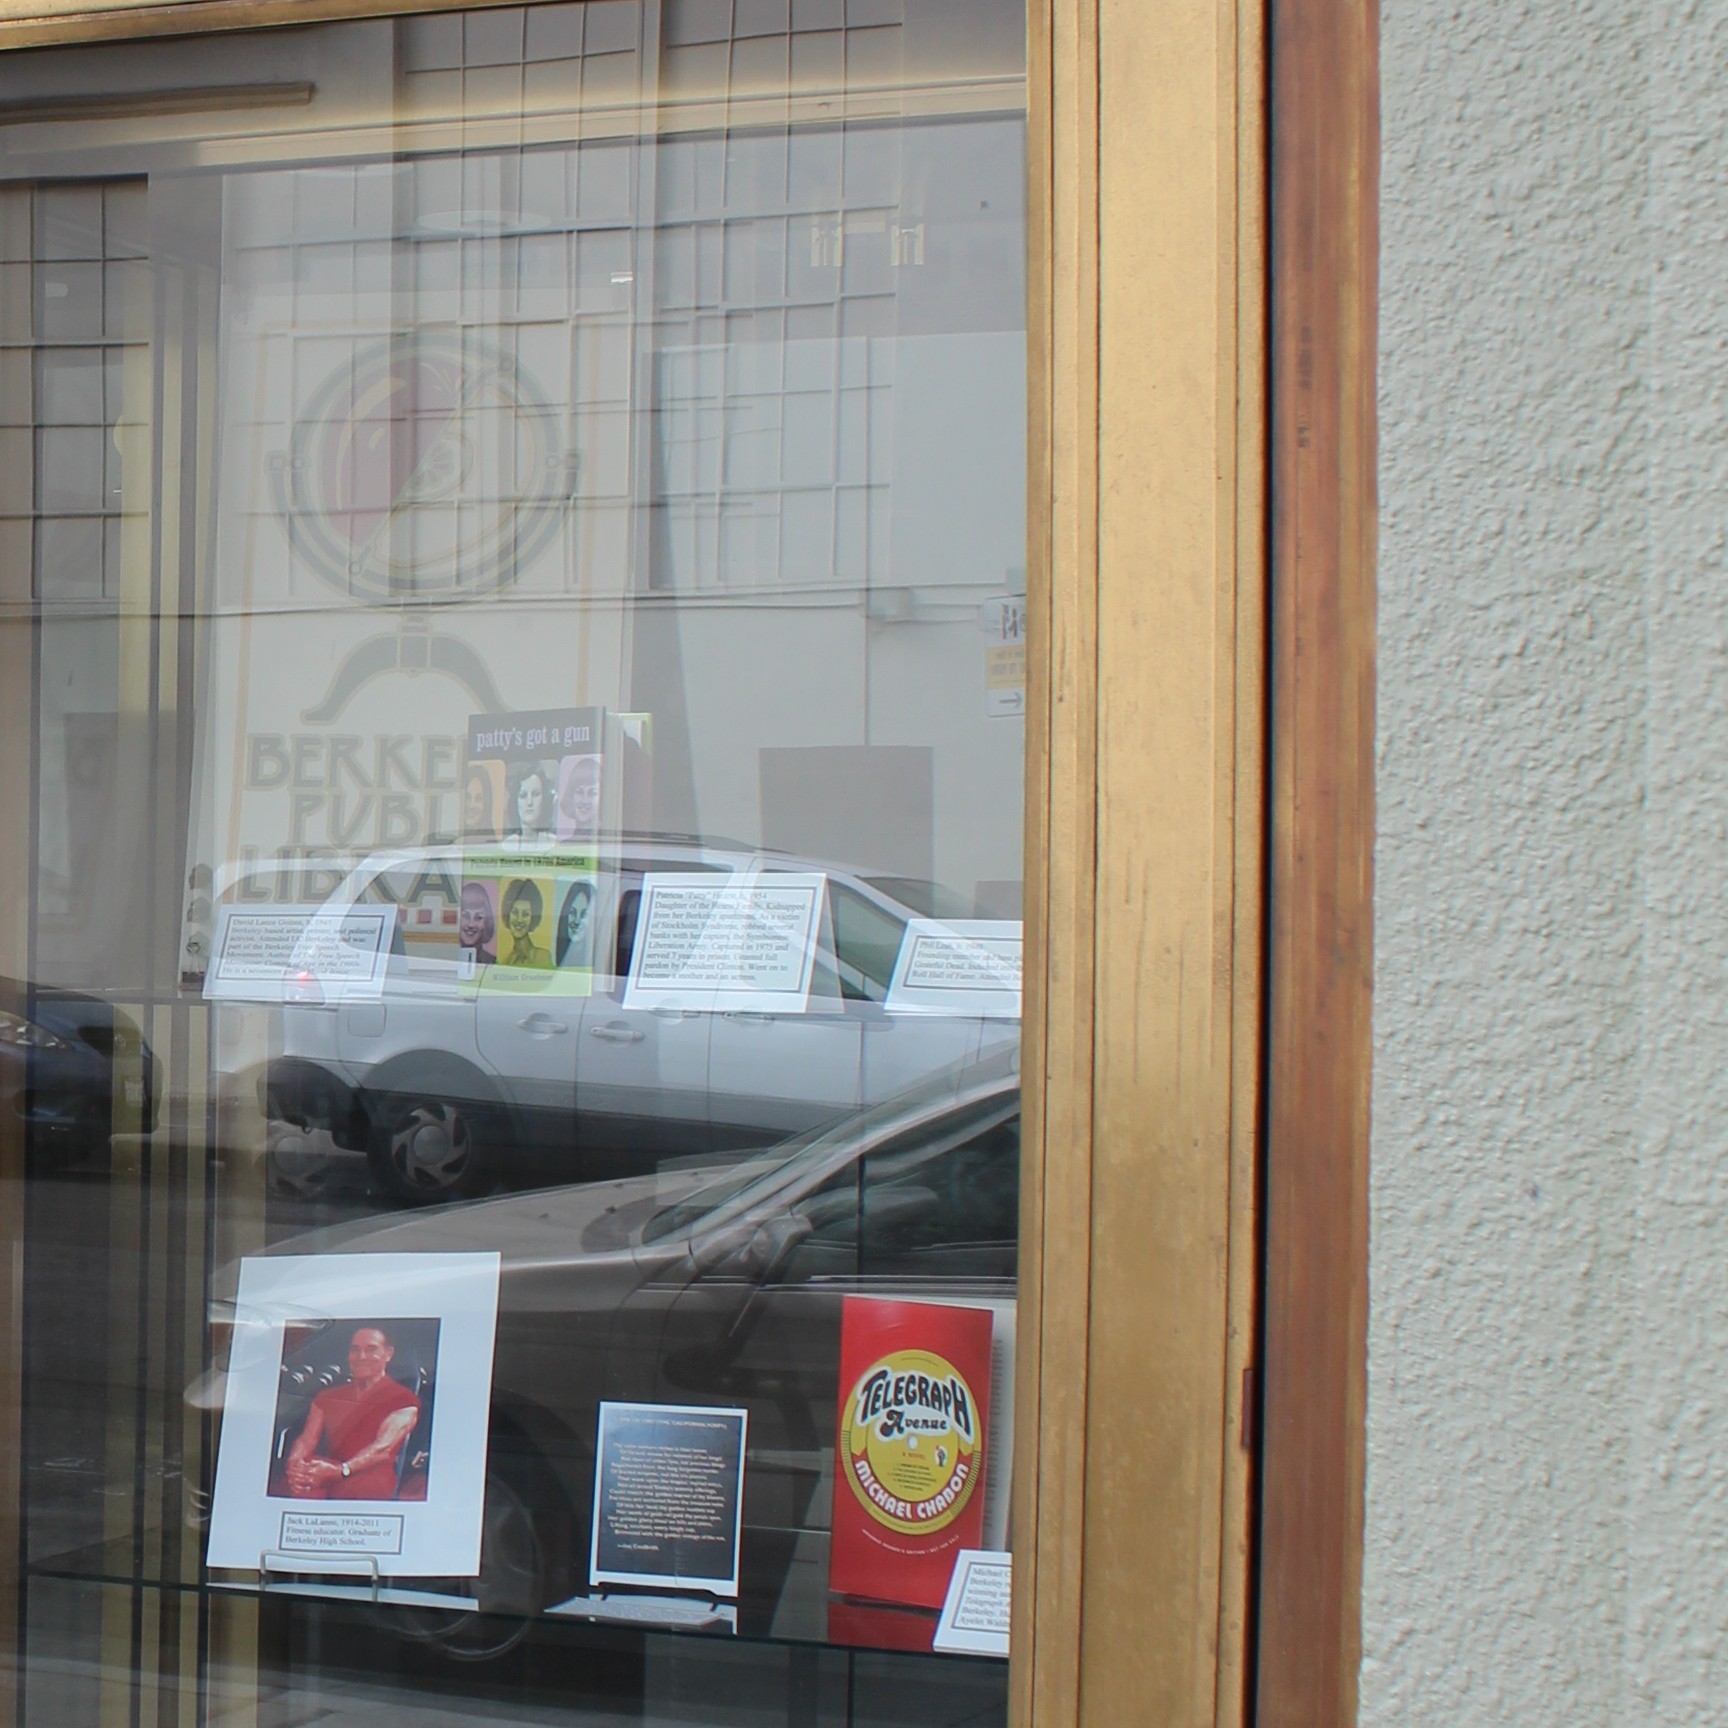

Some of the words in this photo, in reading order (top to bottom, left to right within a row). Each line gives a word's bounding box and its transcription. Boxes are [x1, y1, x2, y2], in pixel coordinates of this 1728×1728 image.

[476, 728, 522, 752] patty's
[526, 728, 547, 749] got
[551, 729, 560, 742] a
[563, 725, 590, 747] gun
[288, 793, 456, 849] PUBL
[237, 845, 460, 904] LIBRA
[879, 1409, 947, 1438] Avenue
[855, 1459, 912, 1519] MICHAEL
[285, 1535, 317, 1544] Berkeley
[319, 1537, 337, 1545] High
